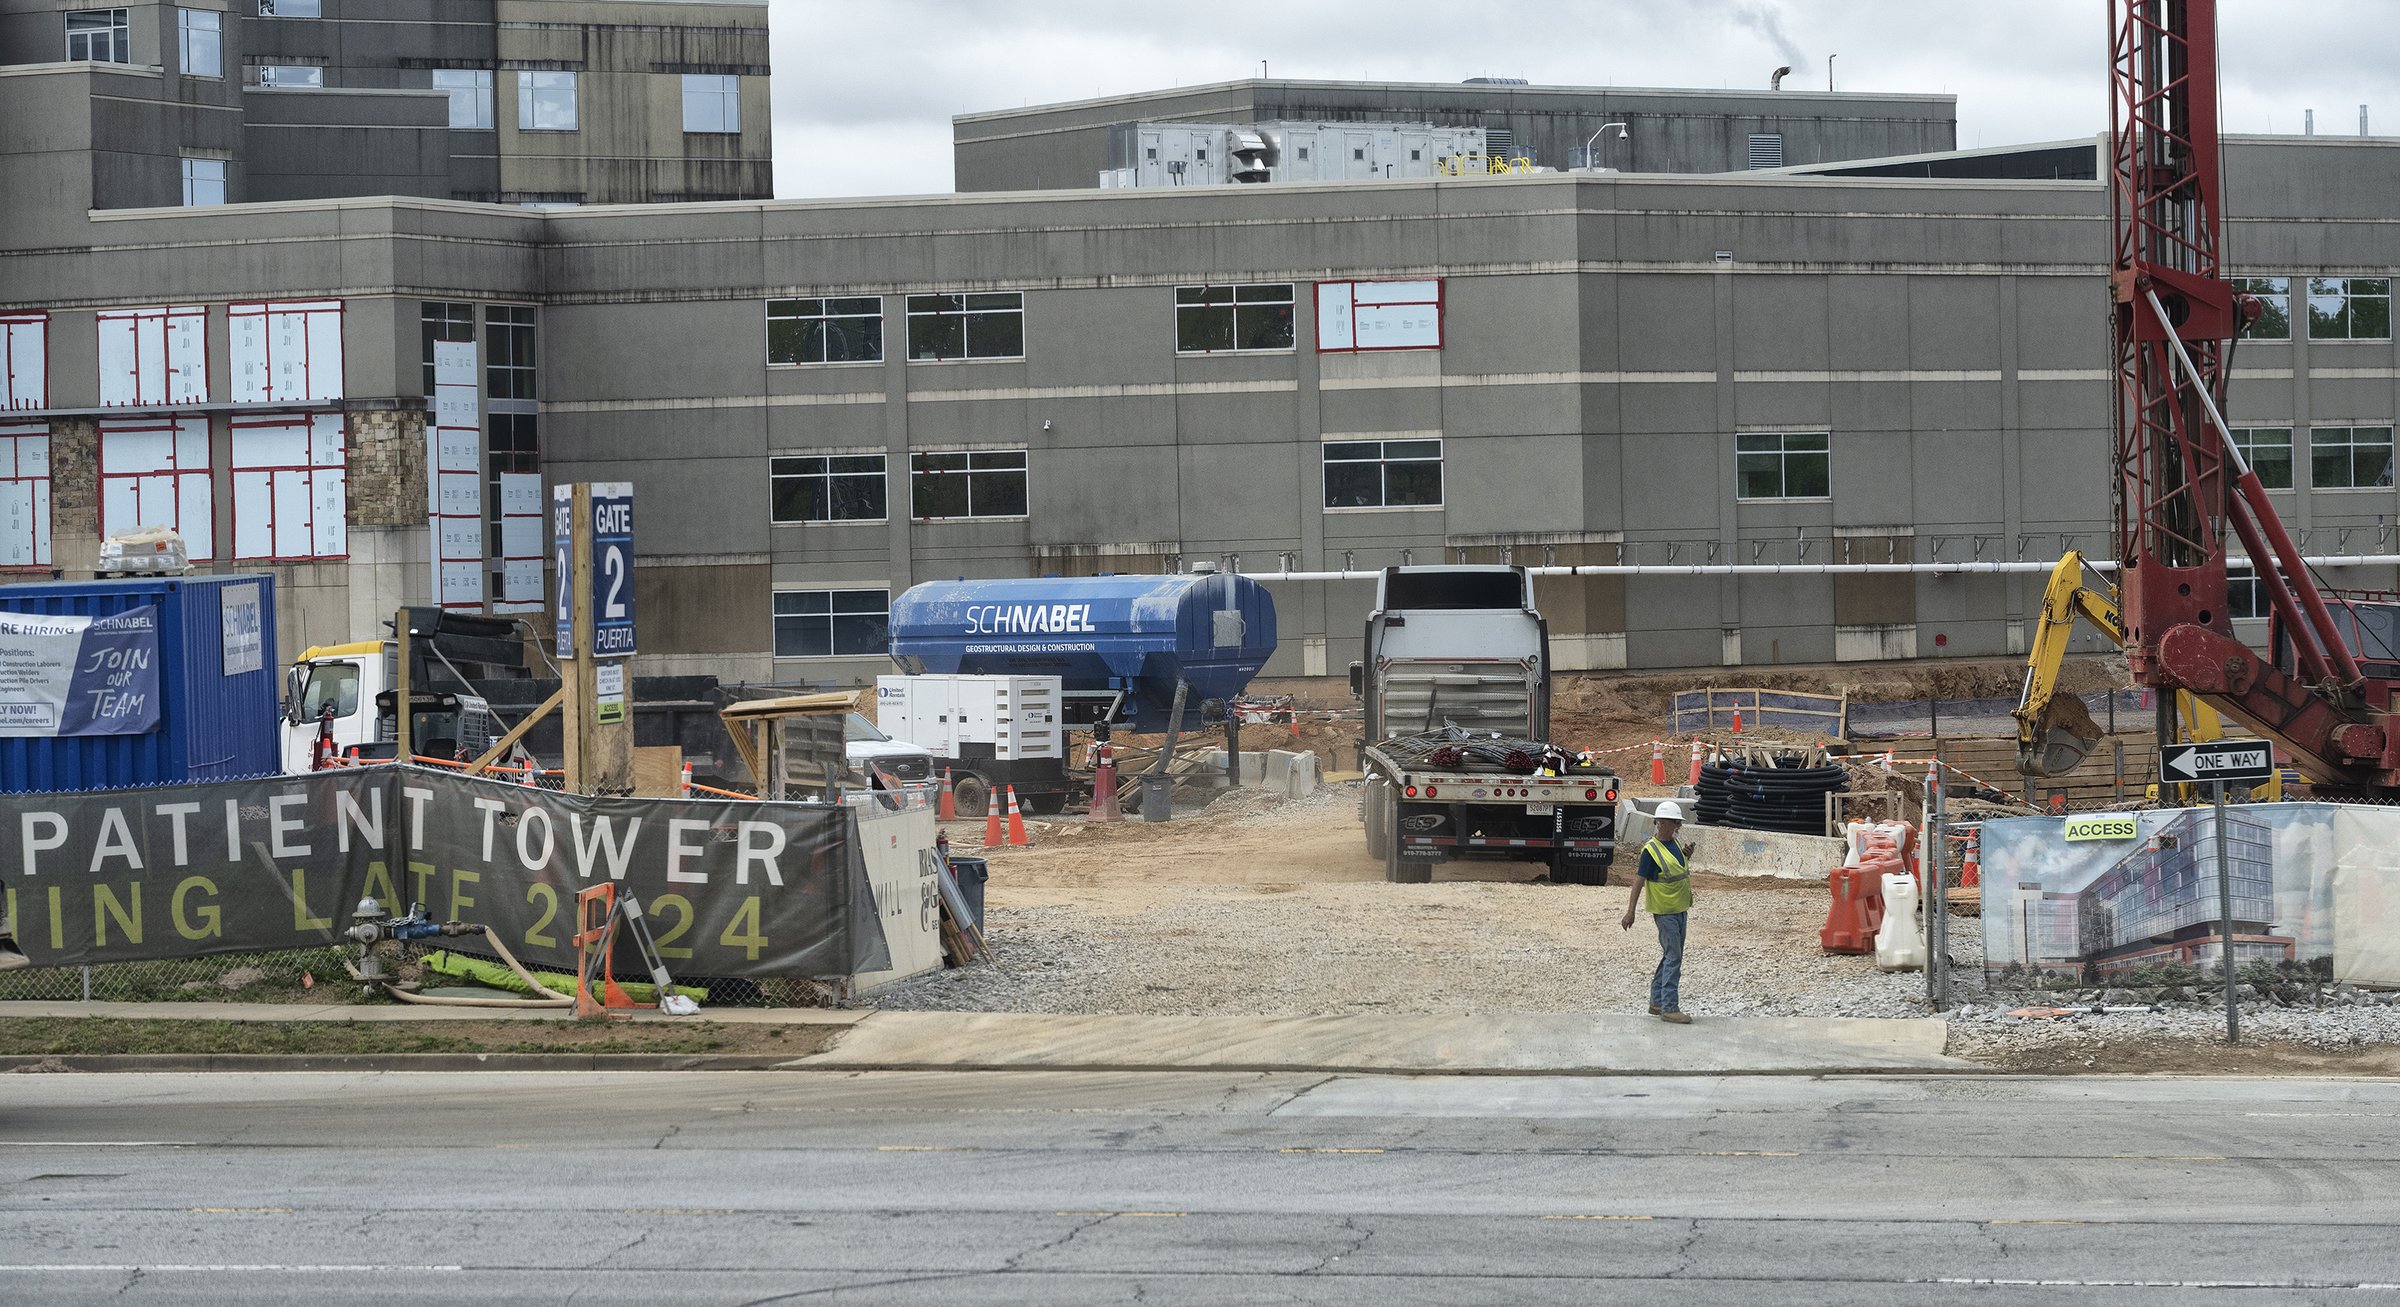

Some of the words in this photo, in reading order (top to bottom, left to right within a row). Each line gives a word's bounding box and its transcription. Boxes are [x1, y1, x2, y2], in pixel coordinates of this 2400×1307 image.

[554, 506, 570, 536] GATE
[596, 504, 631, 534] GATE
[557, 547, 568, 620] 2
[605, 545, 625, 618] 2
[23, 625, 76, 635] HIRING
[94, 617, 153, 630] SCHNABEL
[225, 602, 259, 638] SCHNABEL
[965, 604, 1096, 634] SCHNABEL
[557, 630, 571, 651] PUERTA
[596, 628, 634, 650] PUERTA
[966, 644, 1017, 653] GEOSTRUCTURAL
[1018, 644, 1040, 652] DESIGN
[1042, 644, 1047, 652] &
[1048, 643, 1095, 652] CONSTRUCTION
[84, 647, 151, 673] JOIN
[106, 670, 132, 688] OUR
[10, 705, 36, 714] NOW!
[86, 688, 146, 720] TEAM
[604, 704, 619, 712] ACCESS
[2194, 754, 2224, 770] ONE
[2230, 752, 2260, 767] WAY
[21, 787, 434, 876] PATIENT
[474, 797, 787, 886] TOWER
[2068, 822, 2134, 838] ACCESS
